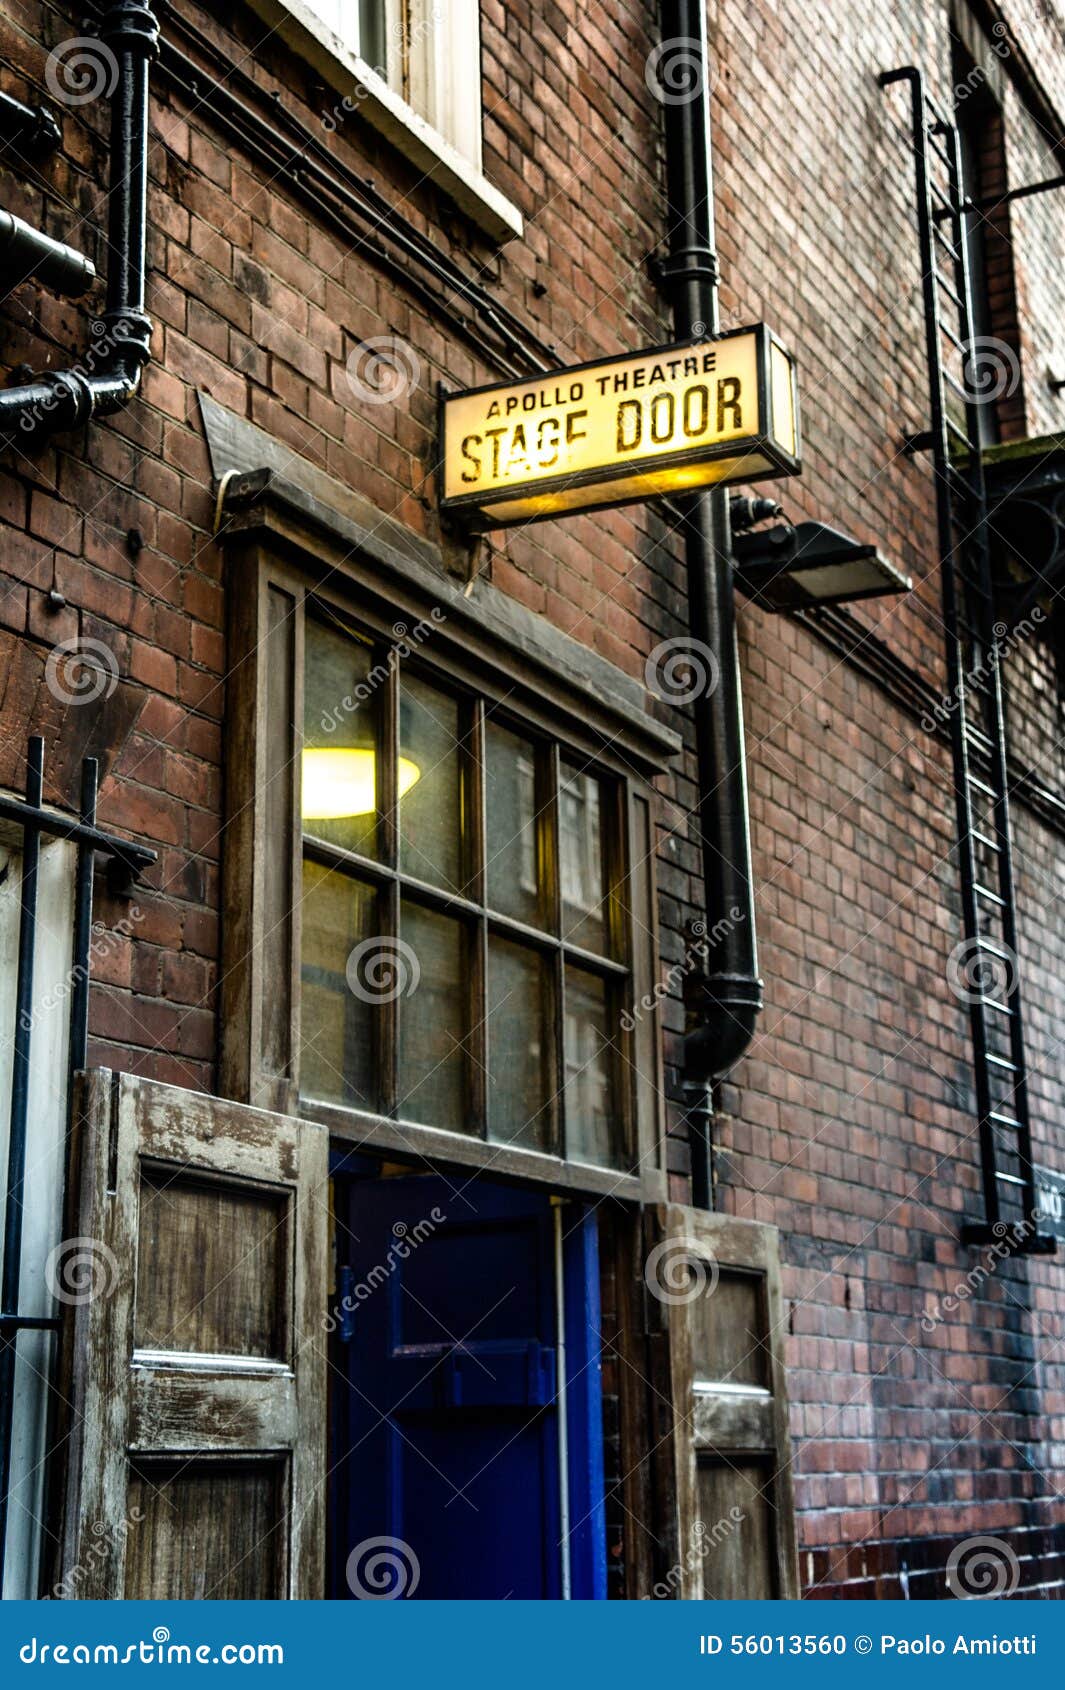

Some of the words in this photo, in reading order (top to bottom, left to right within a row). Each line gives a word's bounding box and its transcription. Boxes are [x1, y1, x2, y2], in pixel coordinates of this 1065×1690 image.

[486, 383, 584, 420] APOLLO
[596, 352, 717, 396] THEATRE
[616, 376, 743, 454] DOOR
